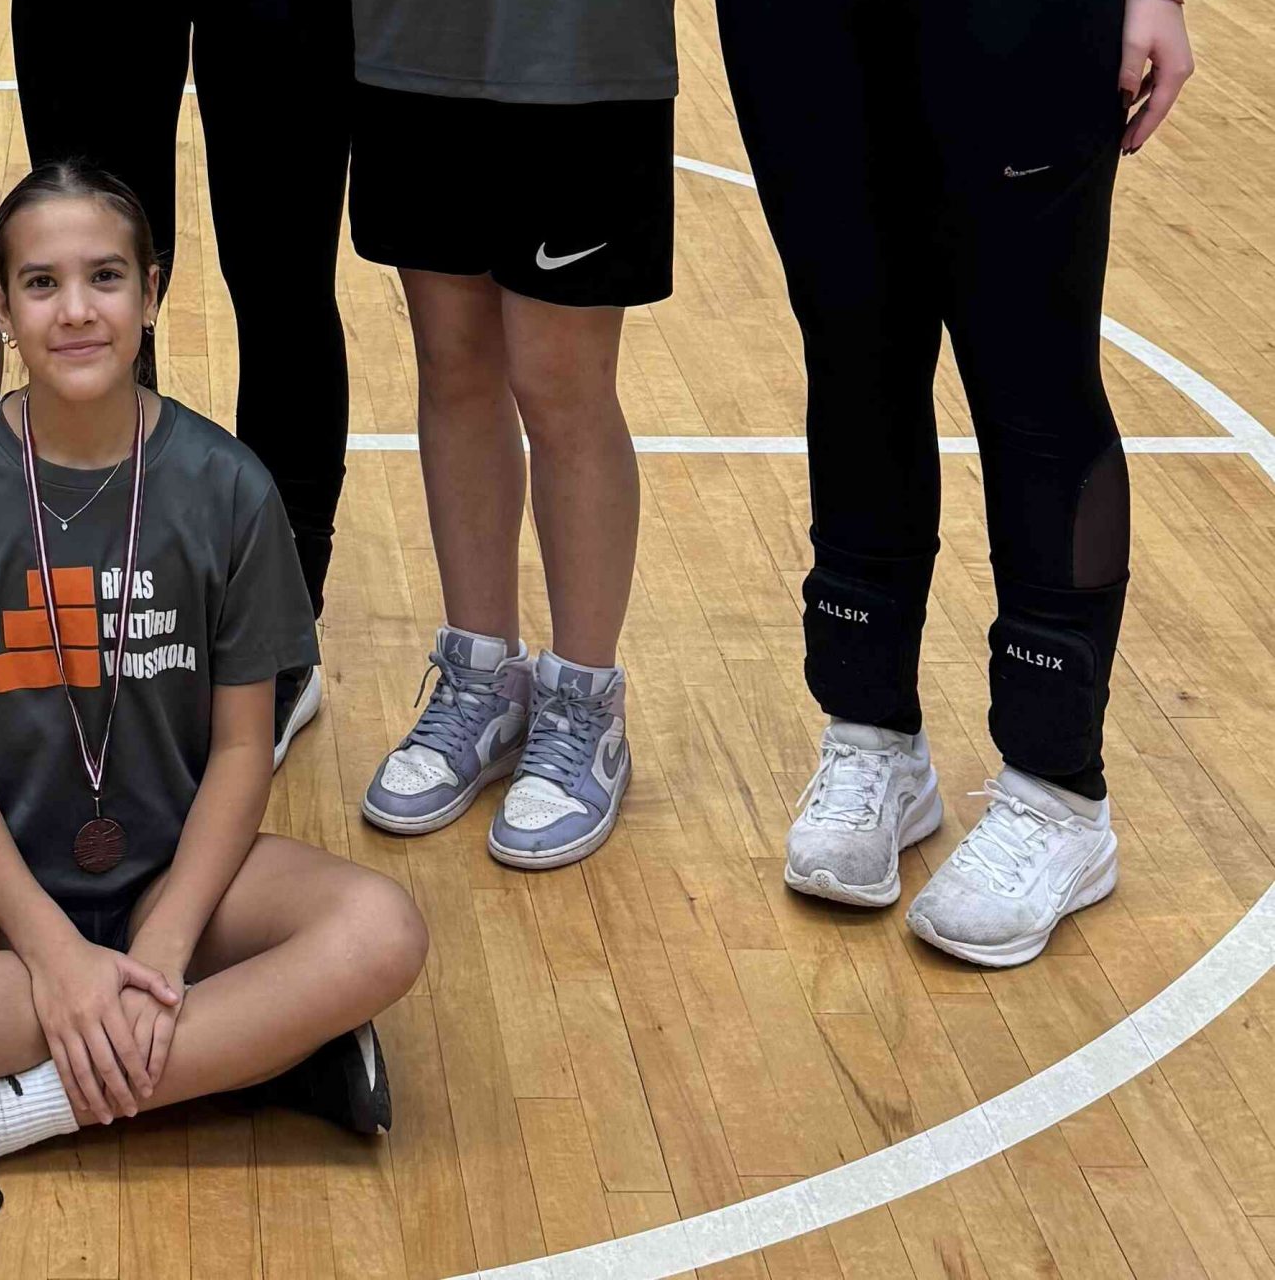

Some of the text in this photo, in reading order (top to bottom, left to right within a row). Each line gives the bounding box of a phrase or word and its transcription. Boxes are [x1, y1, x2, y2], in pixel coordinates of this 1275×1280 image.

[101, 567, 154, 600] RĪAS
[103, 608, 177, 639] KLTŪRU
[818, 599, 870, 624] ALLSIX
[104, 643, 197, 679] VDUSSKOLA
[1006, 644, 1064, 671] ALLSIX
